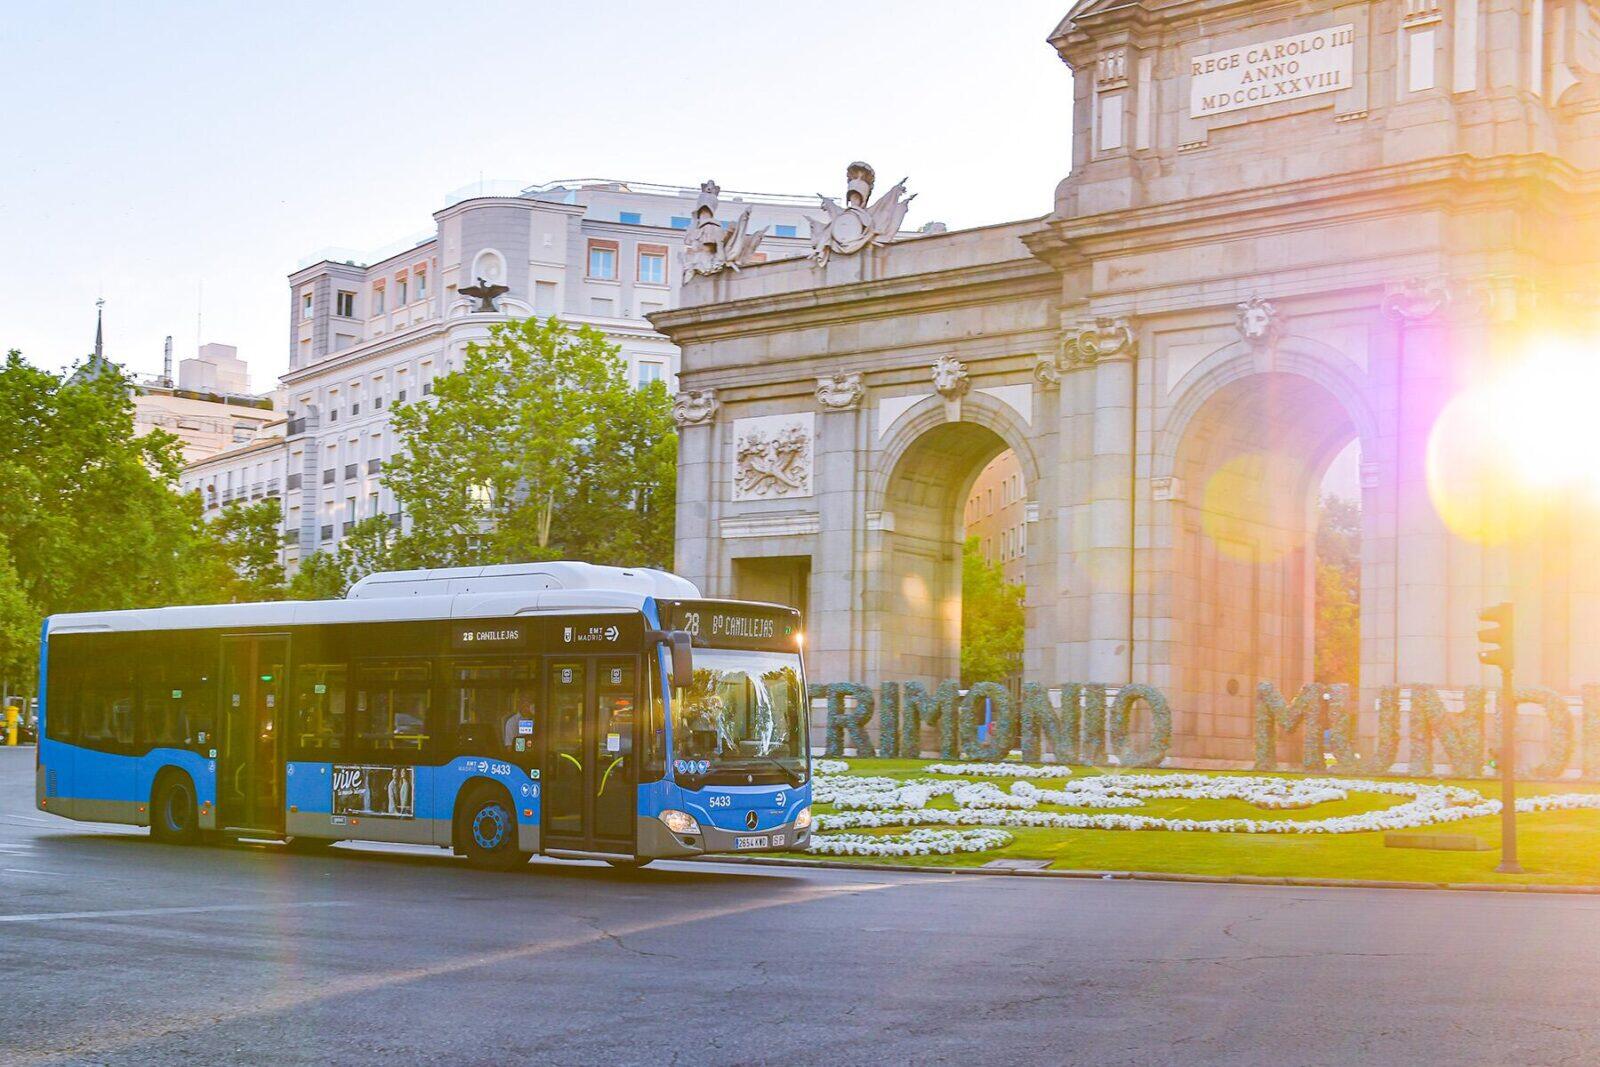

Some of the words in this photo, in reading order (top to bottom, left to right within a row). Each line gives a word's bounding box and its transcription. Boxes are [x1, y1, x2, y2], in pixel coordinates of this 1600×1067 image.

[1192, 54, 1240, 76] REGE
[1247, 37, 1325, 64] CAROLO
[1331, 30, 1353, 47] III
[1241, 61, 1299, 84] ANNO
[1202, 71, 1340, 110] MDCCLXXVIII
[476, 630, 519, 641] CANILLEJAS
[683, 612, 700, 636] 28
[725, 616, 774, 638] CANILLEJAS
[807, 679, 1173, 768] RIMONIO
[491, 764, 511, 775] 5433
[709, 796, 731, 807] 5433
[773, 836, 784, 846] SP
